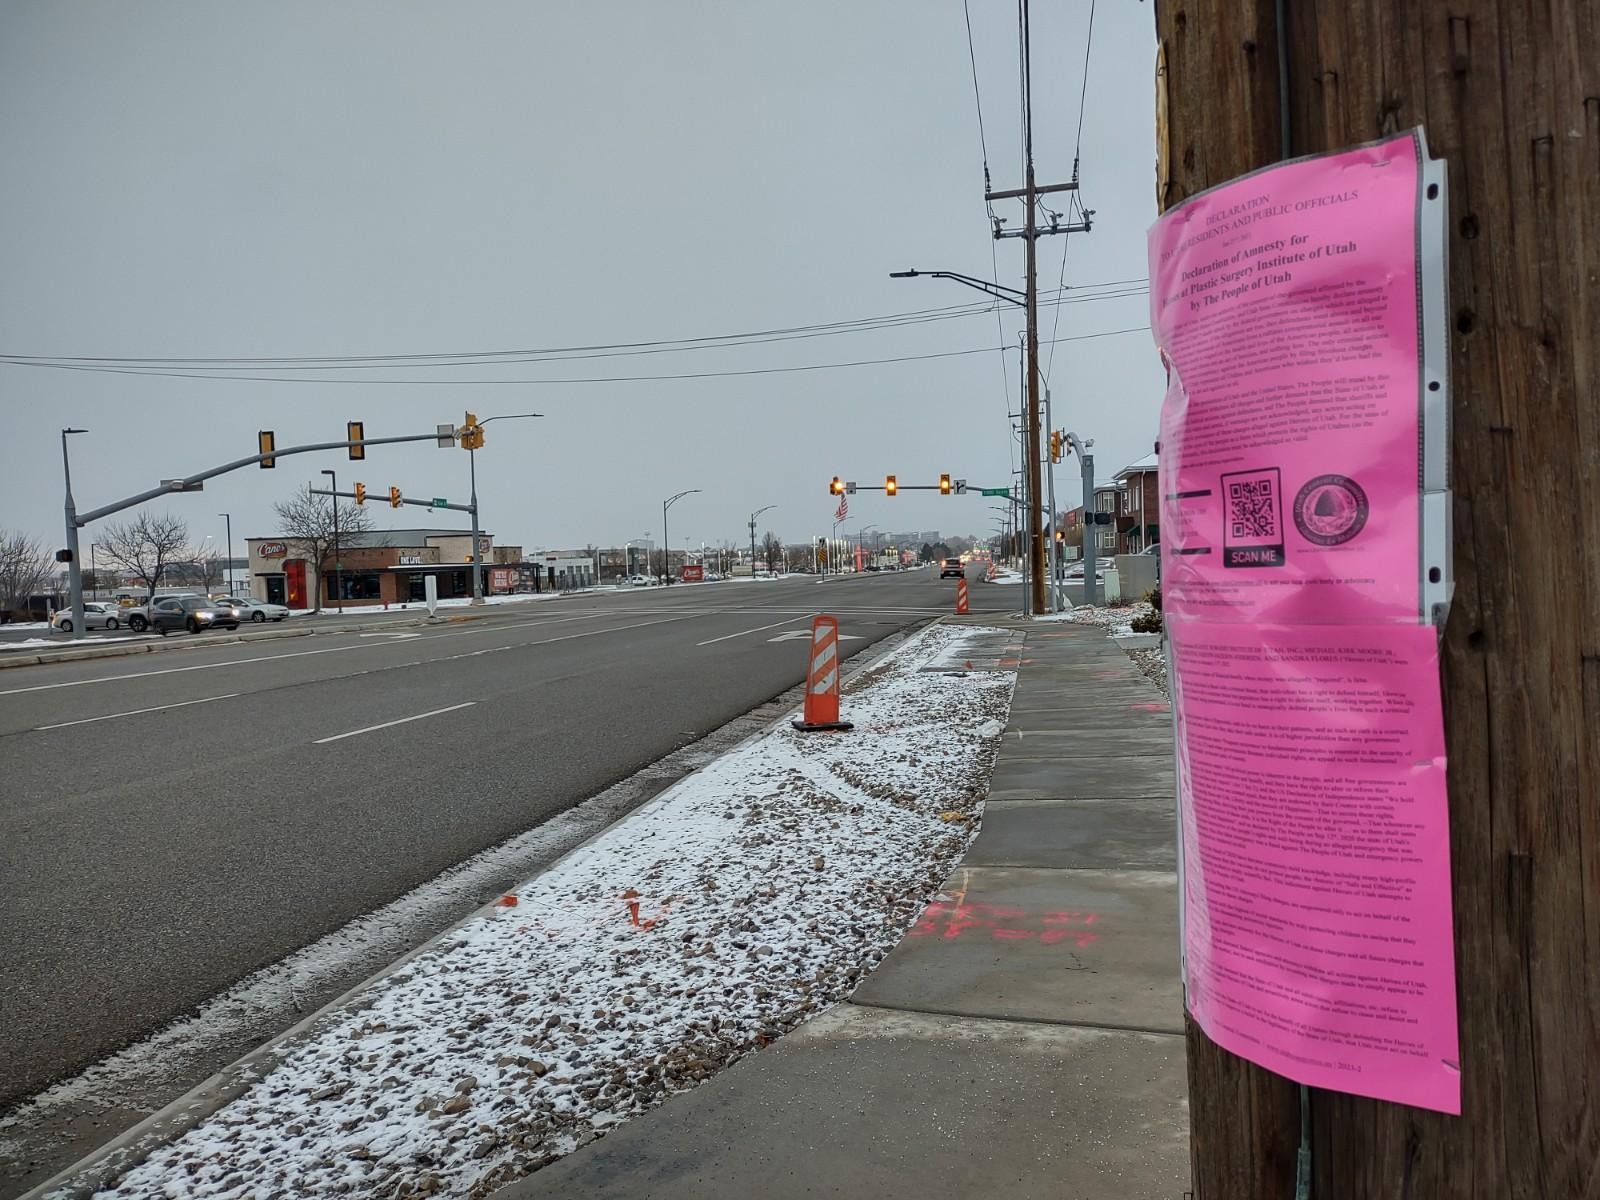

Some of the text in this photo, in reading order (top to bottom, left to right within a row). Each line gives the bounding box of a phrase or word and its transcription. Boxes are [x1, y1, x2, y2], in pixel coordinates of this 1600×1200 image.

[1206, 194, 1270, 226] DECLARATION
[1231, 214, 1251, 231] AND
[1253, 203, 1292, 223] PUBLIC
[1295, 190, 1359, 212] OFFICIALS
[1182, 233, 1309, 282] Declaration of Amnesty for
[1191, 278, 1218, 295] Plastic
[1220, 266, 1253, 286] Surgery
[1257, 254, 1305, 271] Institute
[1309, 245, 1322, 259] of
[1326, 241, 1357, 256] Utah
[1190, 299, 1200, 312] by
[1203, 293, 1219, 306] The
[1221, 284, 1248, 302] People
[1251, 277, 1262, 290] of
[1264, 271, 1292, 287] Utah
[1231, 550, 1277, 563] SCAN ME
